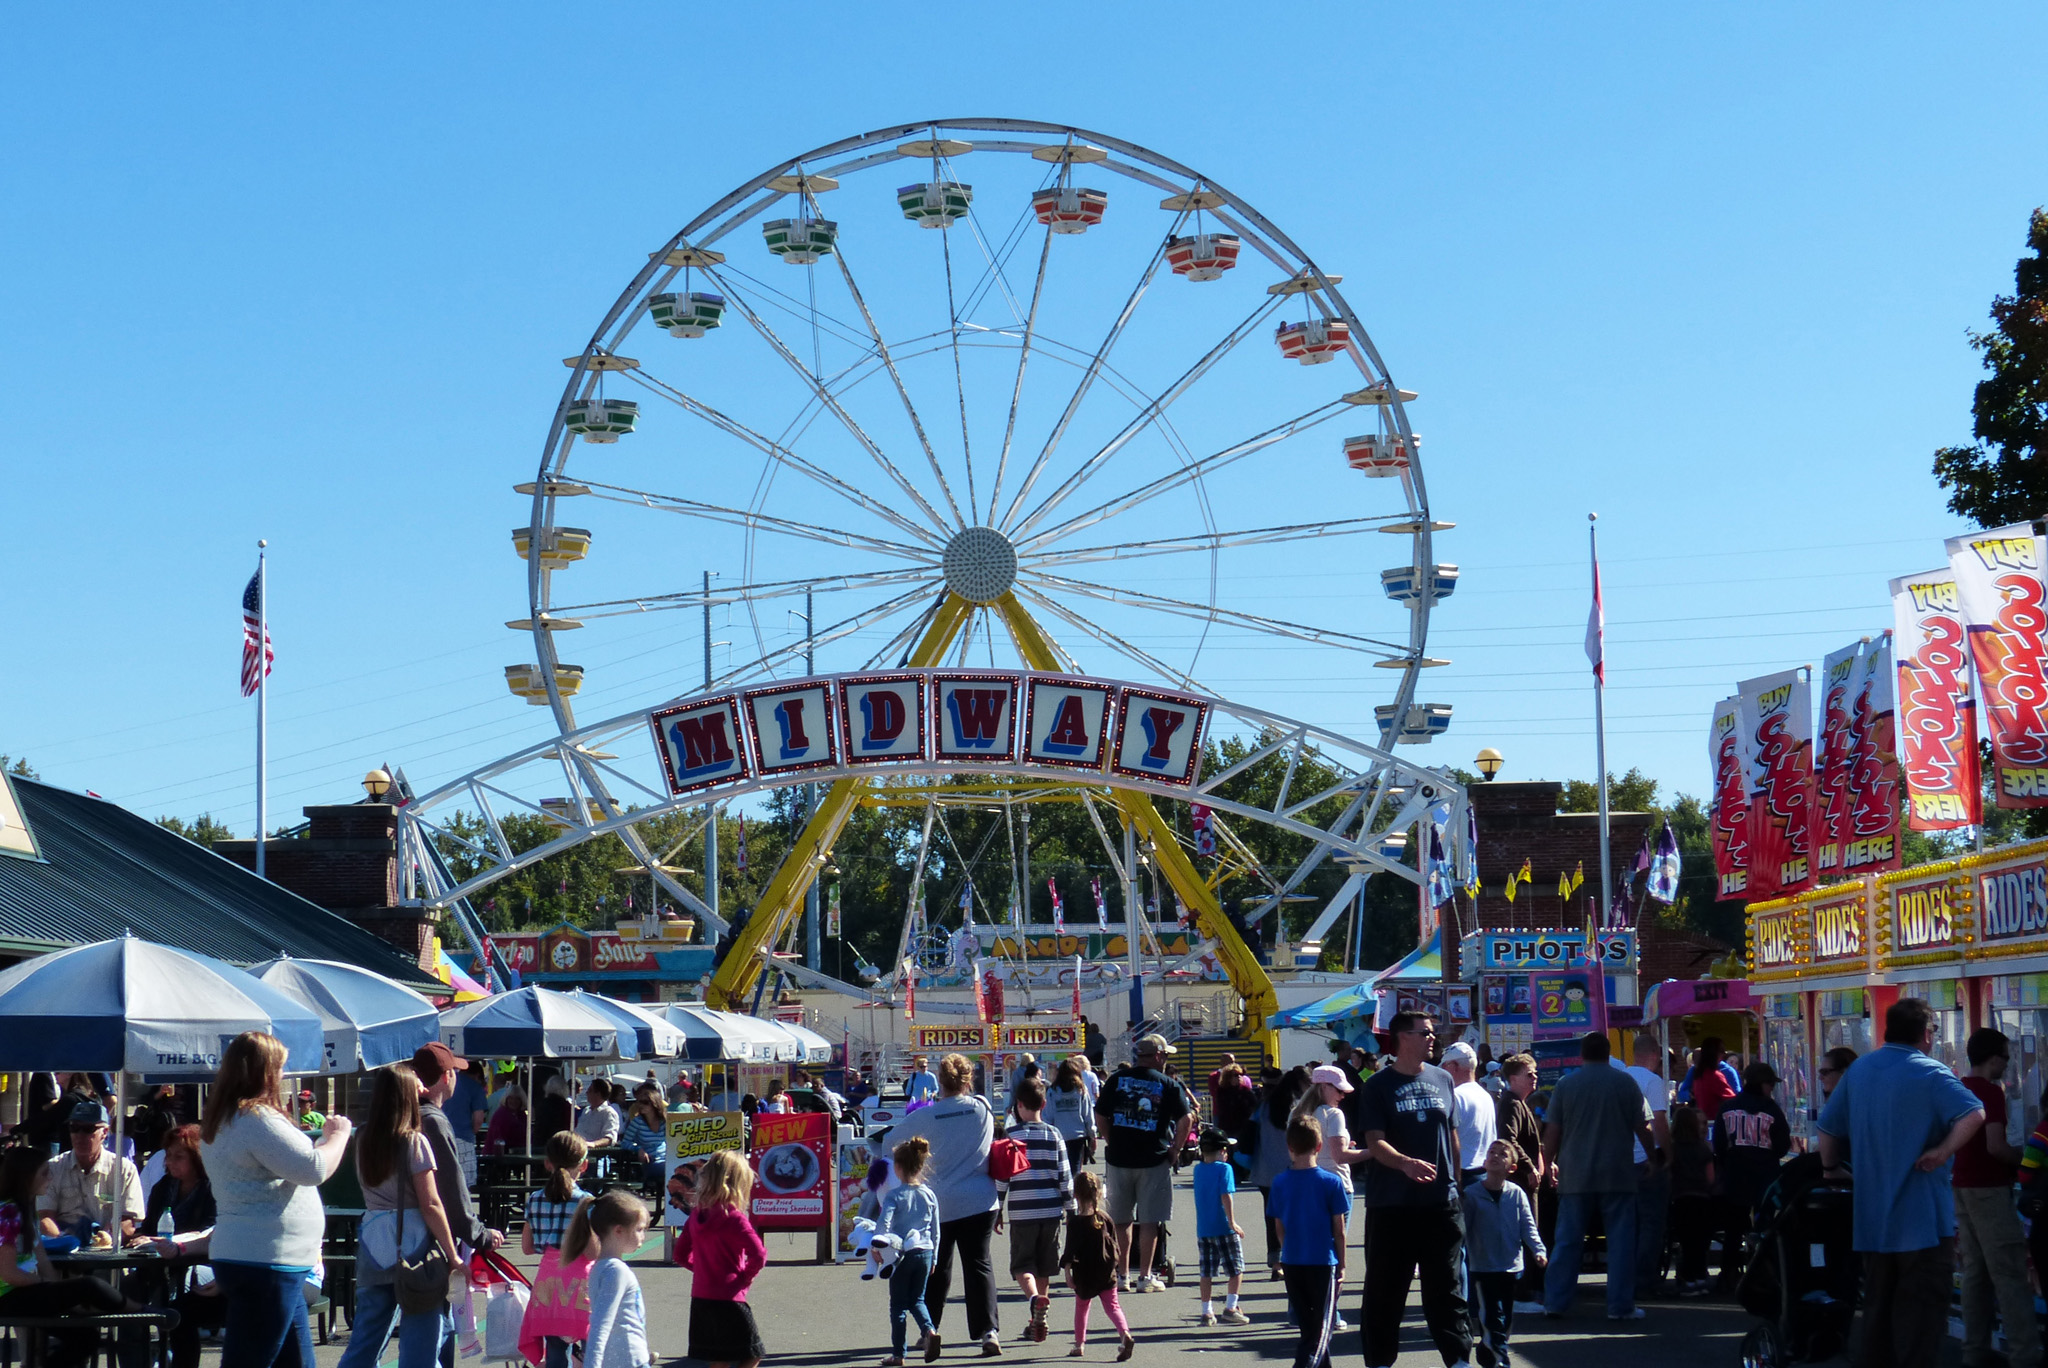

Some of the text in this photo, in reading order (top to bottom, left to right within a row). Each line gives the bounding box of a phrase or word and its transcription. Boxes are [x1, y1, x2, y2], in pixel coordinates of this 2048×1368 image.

[1757, 683, 1792, 717] BUY
[669, 689, 1185, 780] MIDWAY
[1715, 713, 1735, 739] BU
[1843, 834, 1894, 869] HERE
[1722, 870, 1747, 895] HE
[1781, 857, 1808, 886] HE
[1982, 866, 2048, 935] RIDES
[1899, 884, 1952, 946] RIDES
[1760, 915, 1795, 963] RIDES
[1815, 902, 1860, 957] RIDES
[1546, 996, 1559, 1013] 2
[1694, 982, 1728, 1002] EXIT
[589, 1035, 603, 1052] E
[924, 1030, 980, 1046] RIDES
[1014, 1029, 1070, 1045] RIDES
[156, 1053, 217, 1065] THE BIG
[1395, 1097, 1445, 1112] HUSKIES
[670, 1115, 727, 1137] FRIED
[686, 1128, 738, 1143] Girl Scout
[755, 1119, 807, 1146] NEW
[1722, 1109, 1775, 1150] PINK
[676, 1138, 741, 1158] Samoas
